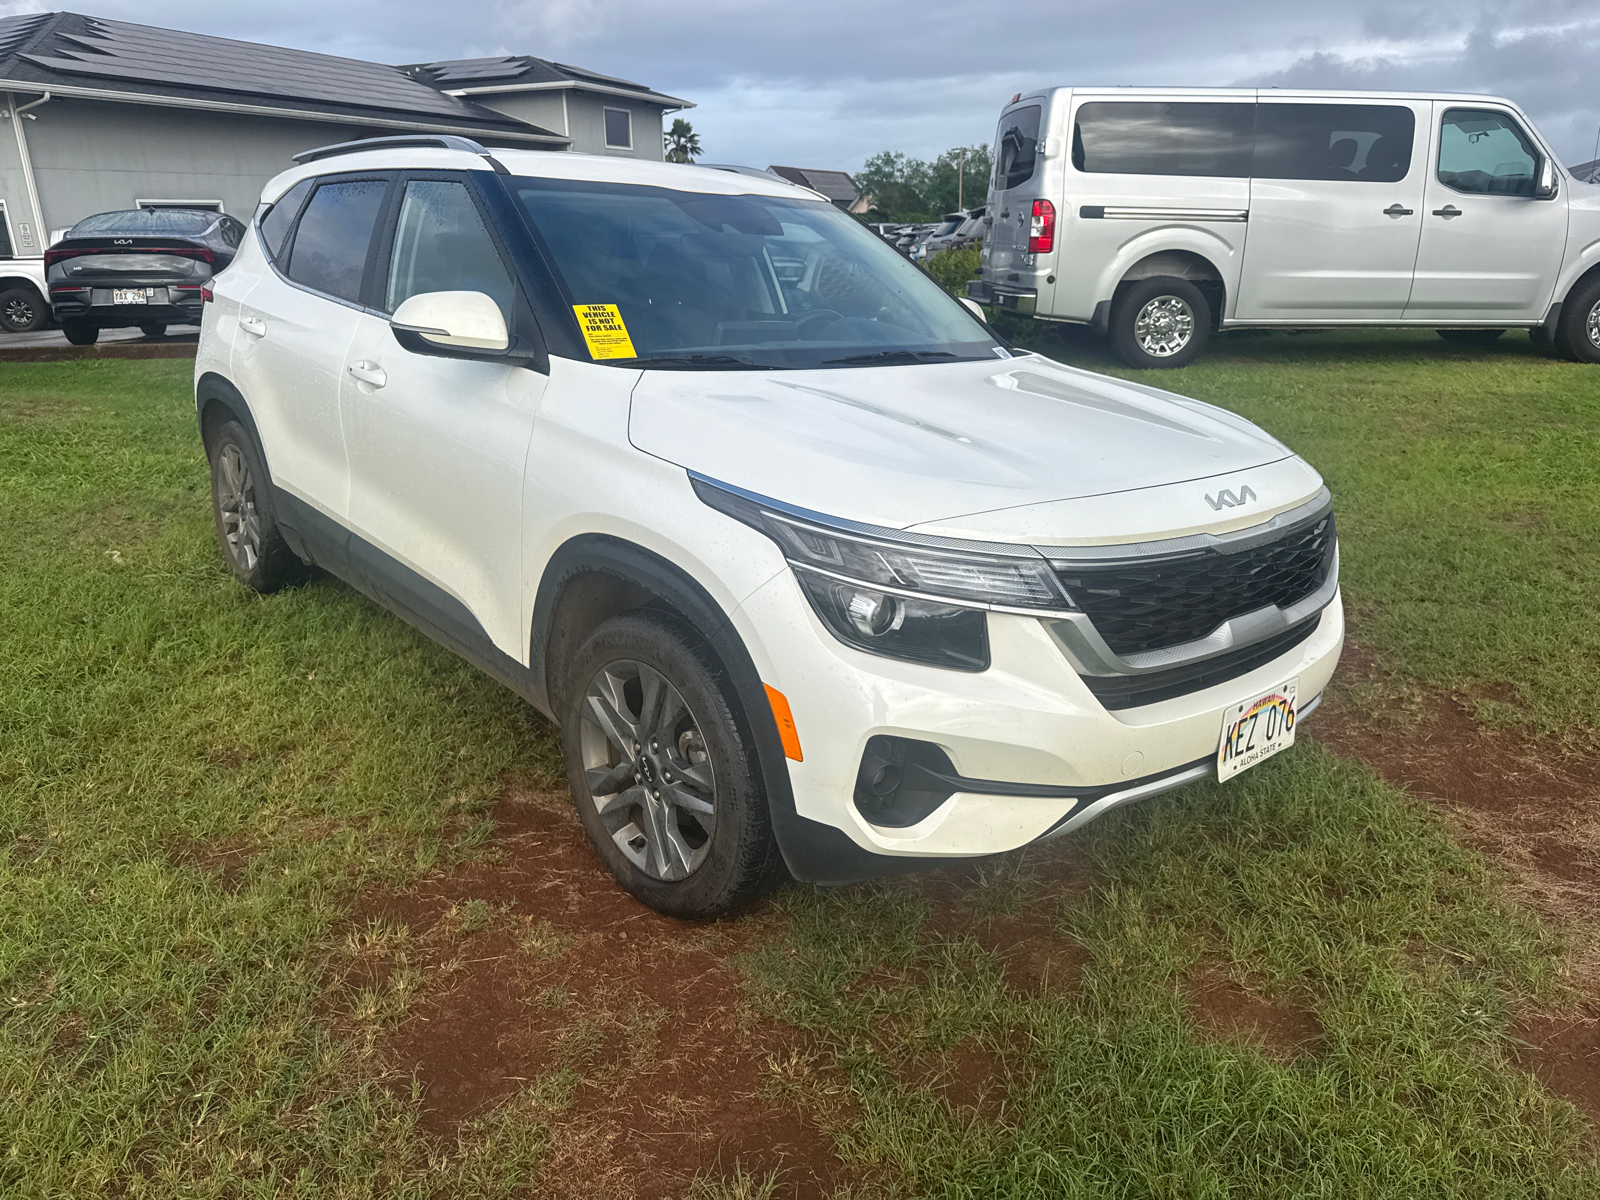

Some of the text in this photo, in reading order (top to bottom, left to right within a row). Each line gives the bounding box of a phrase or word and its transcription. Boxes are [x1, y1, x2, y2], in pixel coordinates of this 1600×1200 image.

[132, 292, 146, 300] 294
[582, 311, 616, 319] VEHICLE
[598, 317, 615, 325] NOT
[1204, 485, 1256, 511] KIA
[1223, 695, 1296, 763] KEZ 076
[1240, 742, 1277, 768] ALOHA STATE
